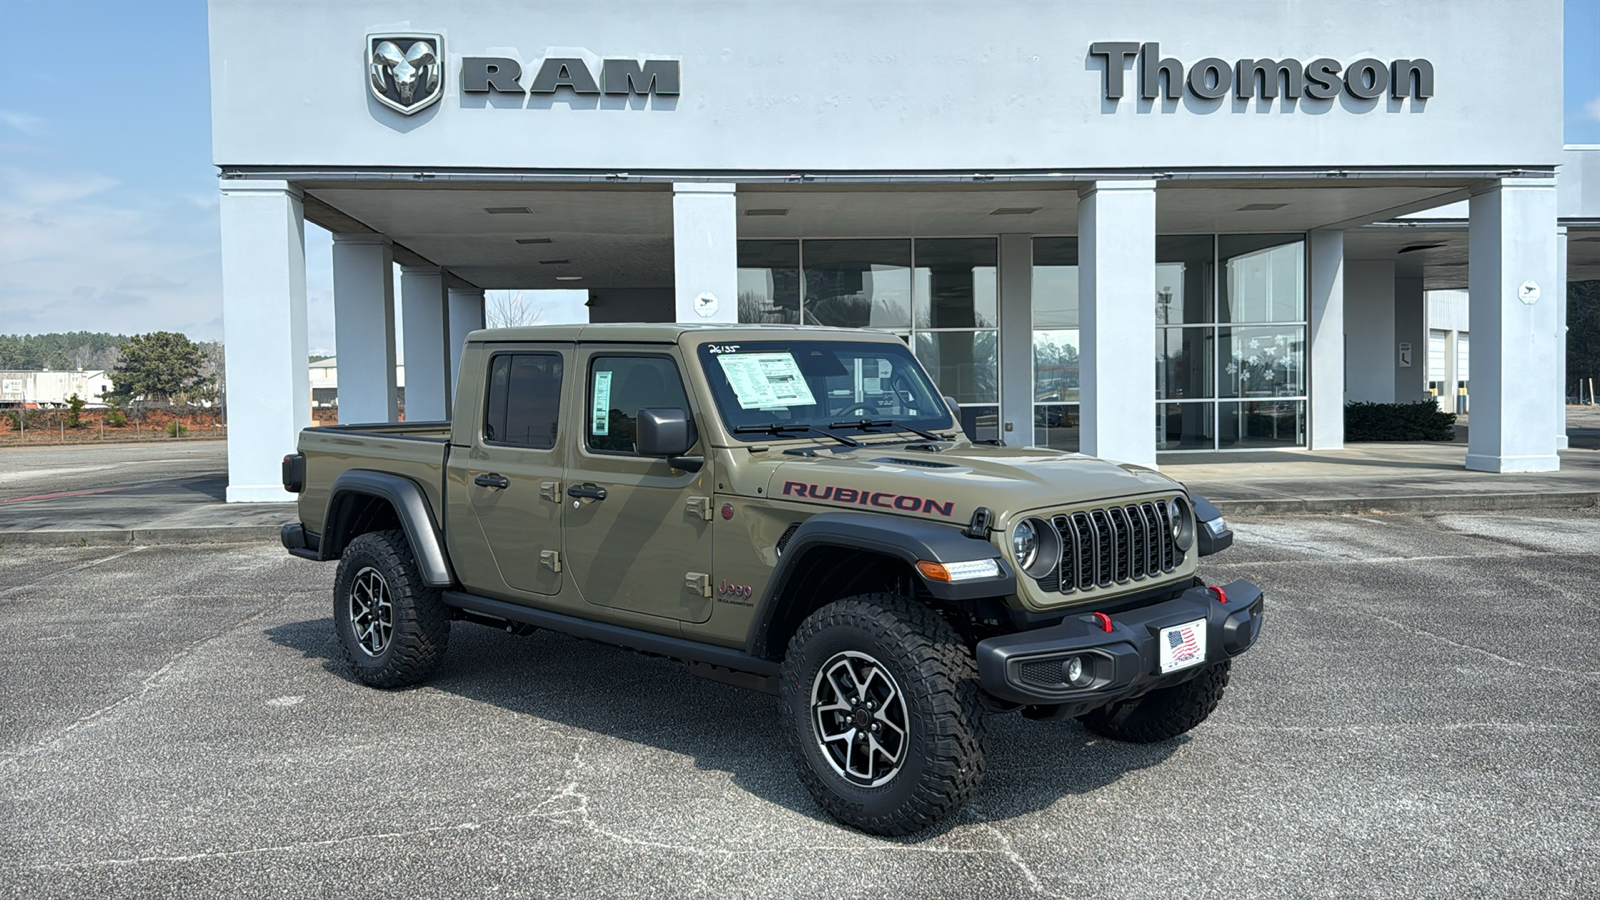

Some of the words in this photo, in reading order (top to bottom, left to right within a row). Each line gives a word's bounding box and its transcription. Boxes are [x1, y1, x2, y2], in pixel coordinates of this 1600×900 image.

[461, 56, 681, 97] RAM
[1089, 41, 1435, 101] Thomson
[782, 481, 955, 517] RUBICON
[717, 578, 752, 601] Jeep
